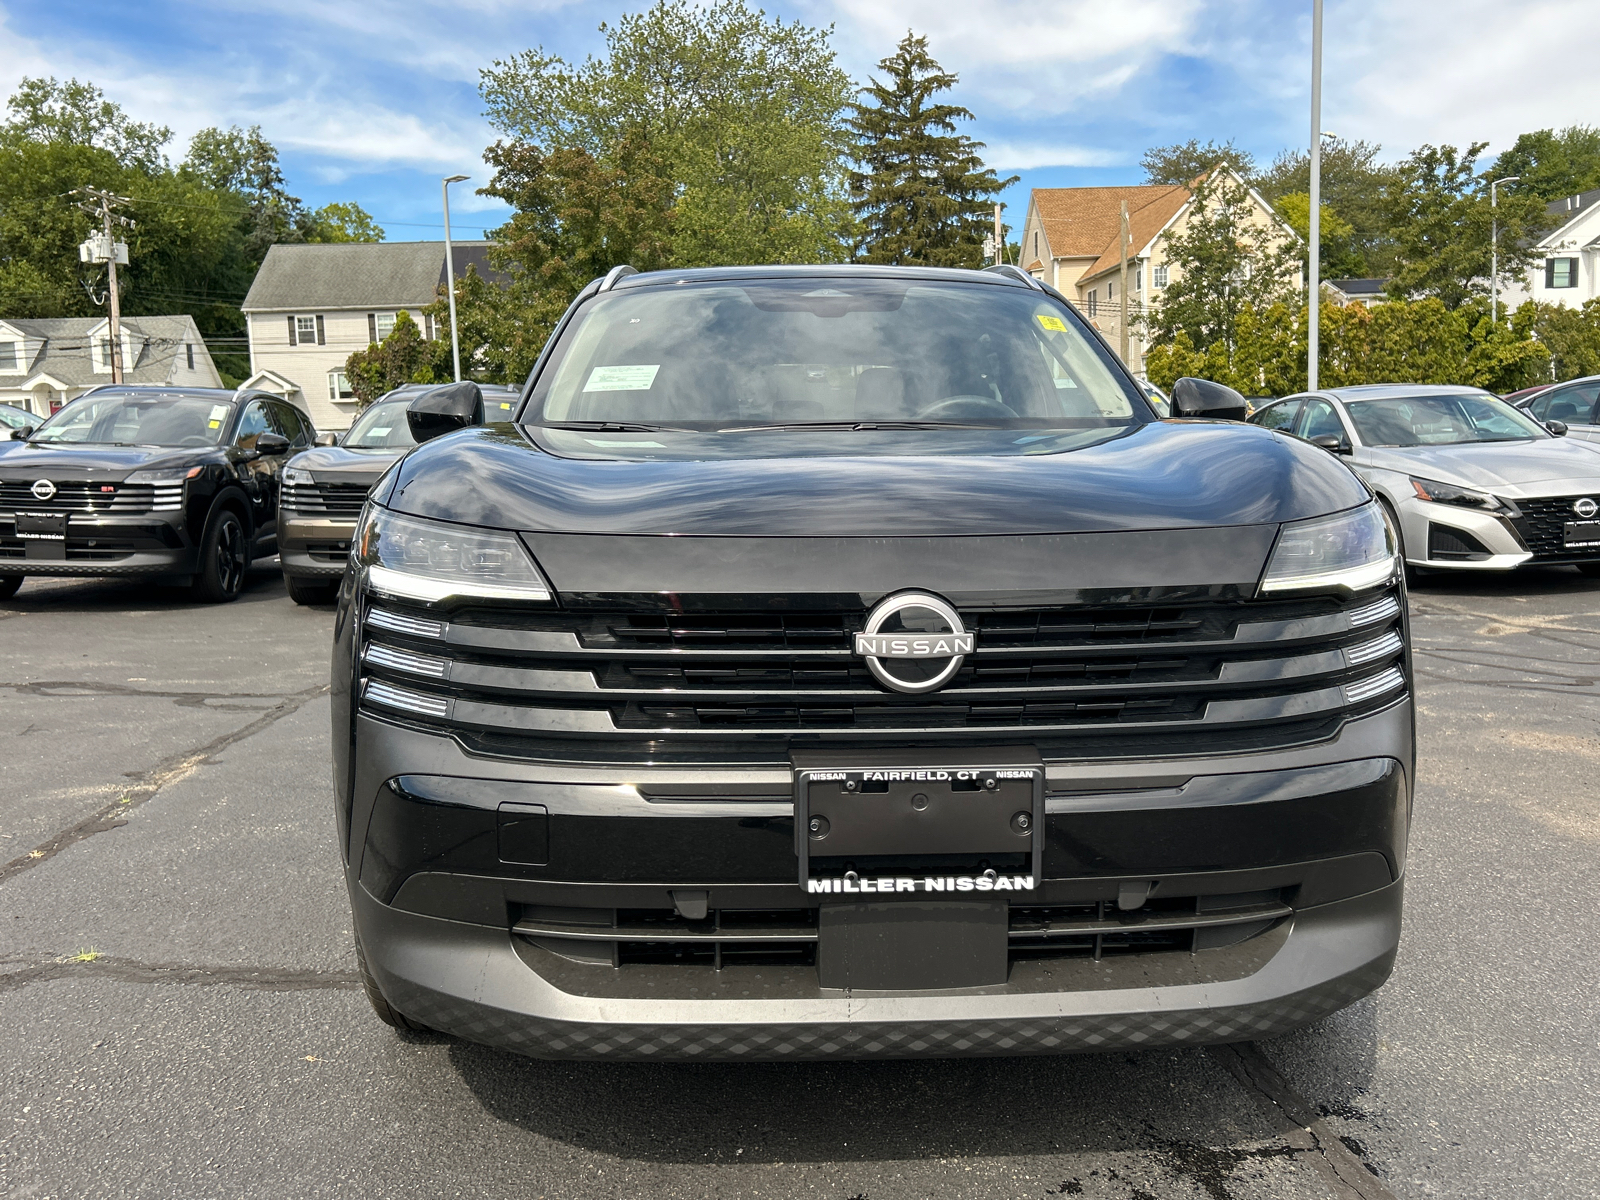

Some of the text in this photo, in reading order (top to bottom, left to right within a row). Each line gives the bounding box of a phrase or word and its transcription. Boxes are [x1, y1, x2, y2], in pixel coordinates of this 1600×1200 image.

[859, 638, 971, 654] NISSAN
[863, 771, 980, 781] FAIRFIELD, CT
[808, 877, 1034, 893] MILLER NISSAN
